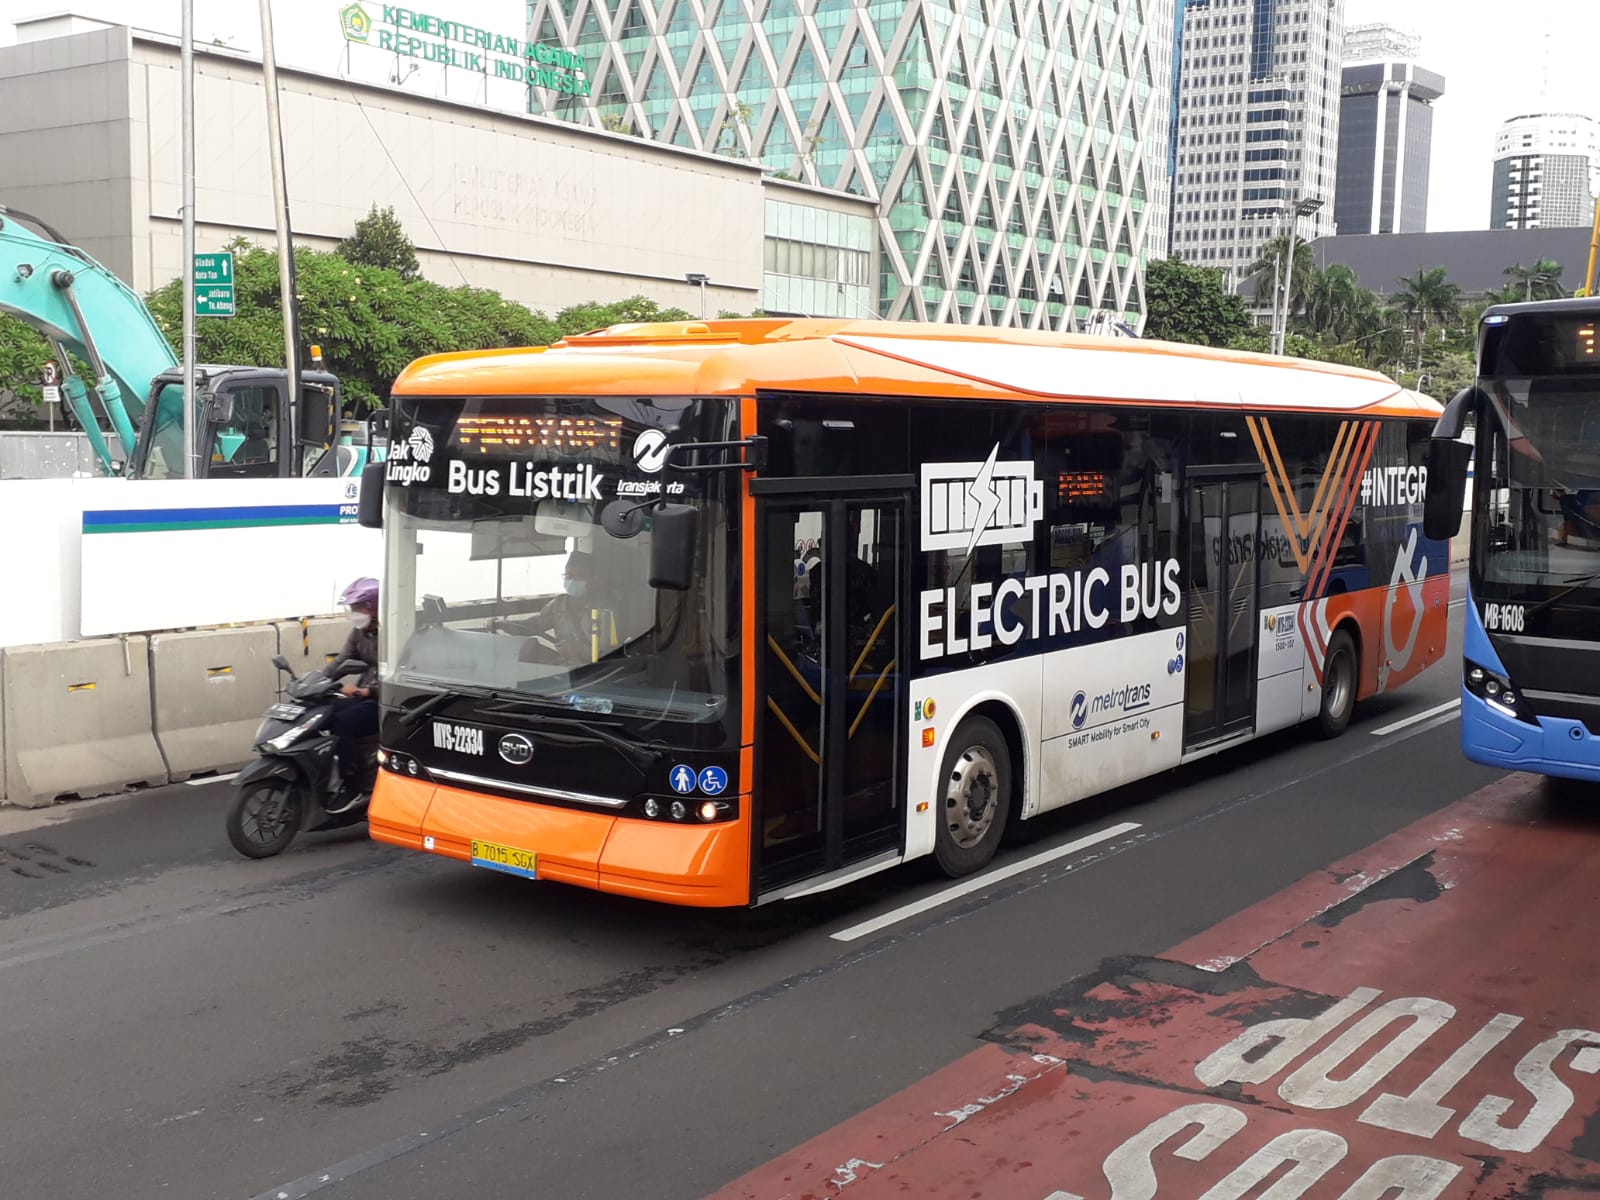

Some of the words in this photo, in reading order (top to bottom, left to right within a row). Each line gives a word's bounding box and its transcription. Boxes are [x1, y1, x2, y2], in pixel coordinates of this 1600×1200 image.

[382, 4, 519, 57] KEMENTERIAN
[524, 41, 586, 71] AGAMA
[379, 29, 483, 73] REPUBLIK
[495, 59, 592, 97] INDONESIA
[387, 439, 410, 460] Jak
[386, 461, 430, 486] Lingko
[448, 459, 500, 496] Bus
[508, 461, 604, 500] Listrik
[615, 479, 685, 496] transjakrta
[1360, 465, 1428, 507] #INTEGR
[339, 505, 359, 516] PRO
[919, 567, 1110, 661] ELECTRIC
[1120, 558, 1181, 624] BUS
[1484, 602, 1525, 633] MB-1608
[1091, 683, 1151, 713] metrotrans
[433, 721, 484, 756] MYS-22334
[1068, 733, 1090, 749] SMART
[1090, 727, 1113, 743] Mobility
[1113, 725, 1122, 737] for
[1122, 719, 1139, 734] Smart
[1139, 717, 1151, 729] City
[501, 741, 529, 757] BYD
[472, 842, 479, 857] B
[483, 844, 508, 864] 7015
[512, 851, 533, 870] SGX
[1194, 985, 1600, 1153] STOP
